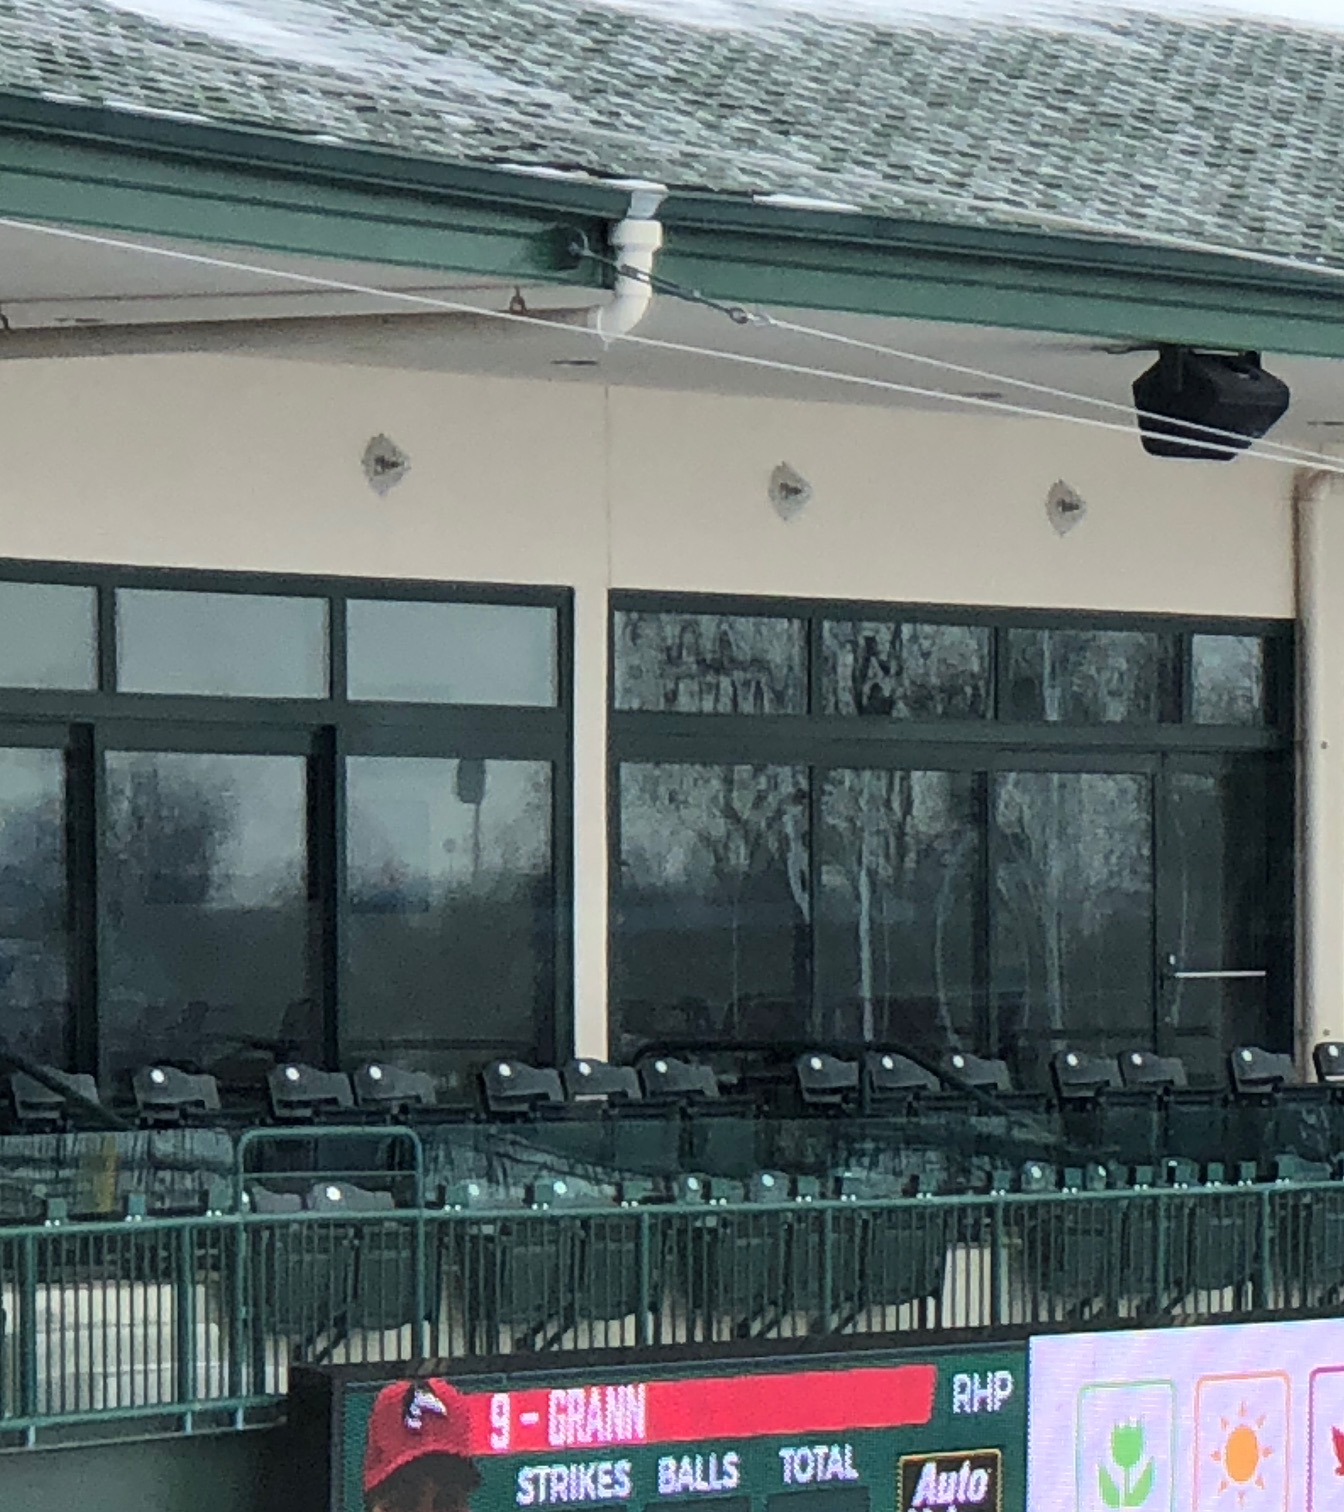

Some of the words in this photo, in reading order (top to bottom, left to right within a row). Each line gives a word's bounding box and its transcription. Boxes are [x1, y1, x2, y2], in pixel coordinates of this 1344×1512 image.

[952, 1371, 1014, 1415] RHP
[490, 1392, 511, 1450] 9
[515, 1458, 633, 1506] STRIKES
[657, 1450, 740, 1495] BALLS
[778, 1443, 860, 1485] TOTAL
[911, 1459, 989, 1508] Auto
